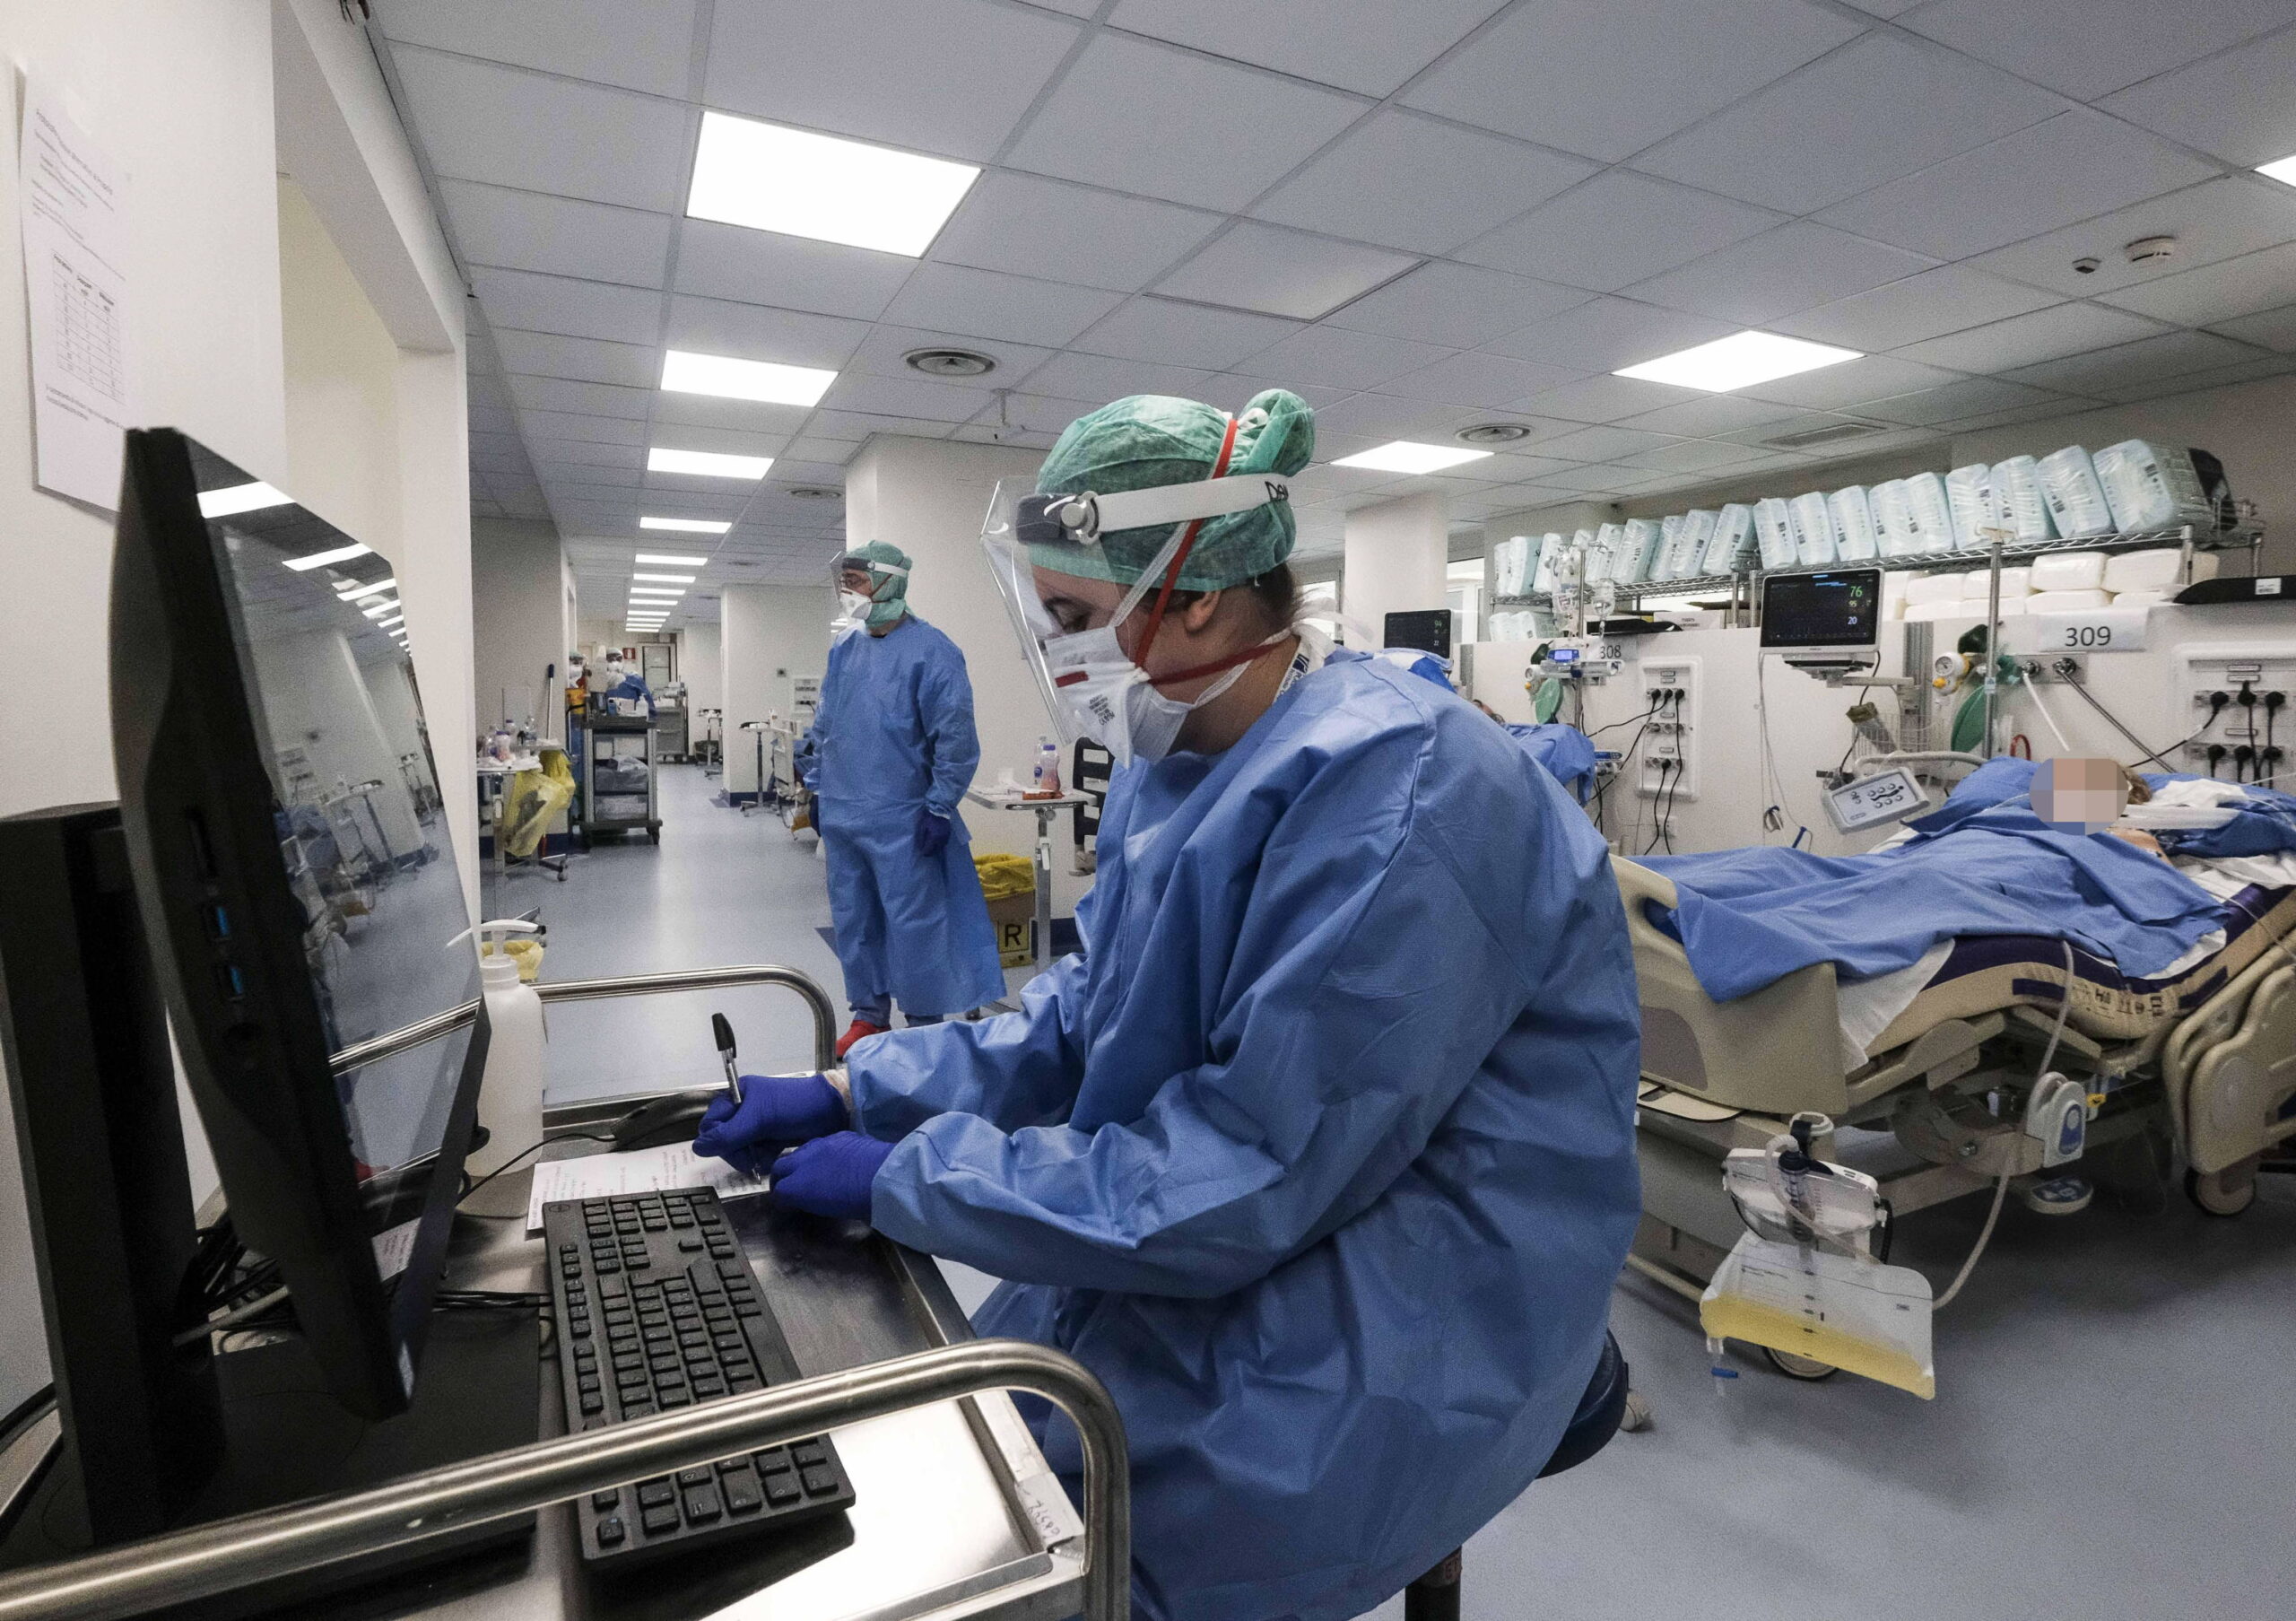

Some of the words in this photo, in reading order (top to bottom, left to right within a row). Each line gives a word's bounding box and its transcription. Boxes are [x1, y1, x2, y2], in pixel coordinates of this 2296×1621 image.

[1850, 586, 1864, 597] 76
[1848, 616, 1857, 625] 20
[2065, 626, 2111, 647] 309
[1600, 645, 1622, 659] 308
[1004, 923, 1022, 947] R
